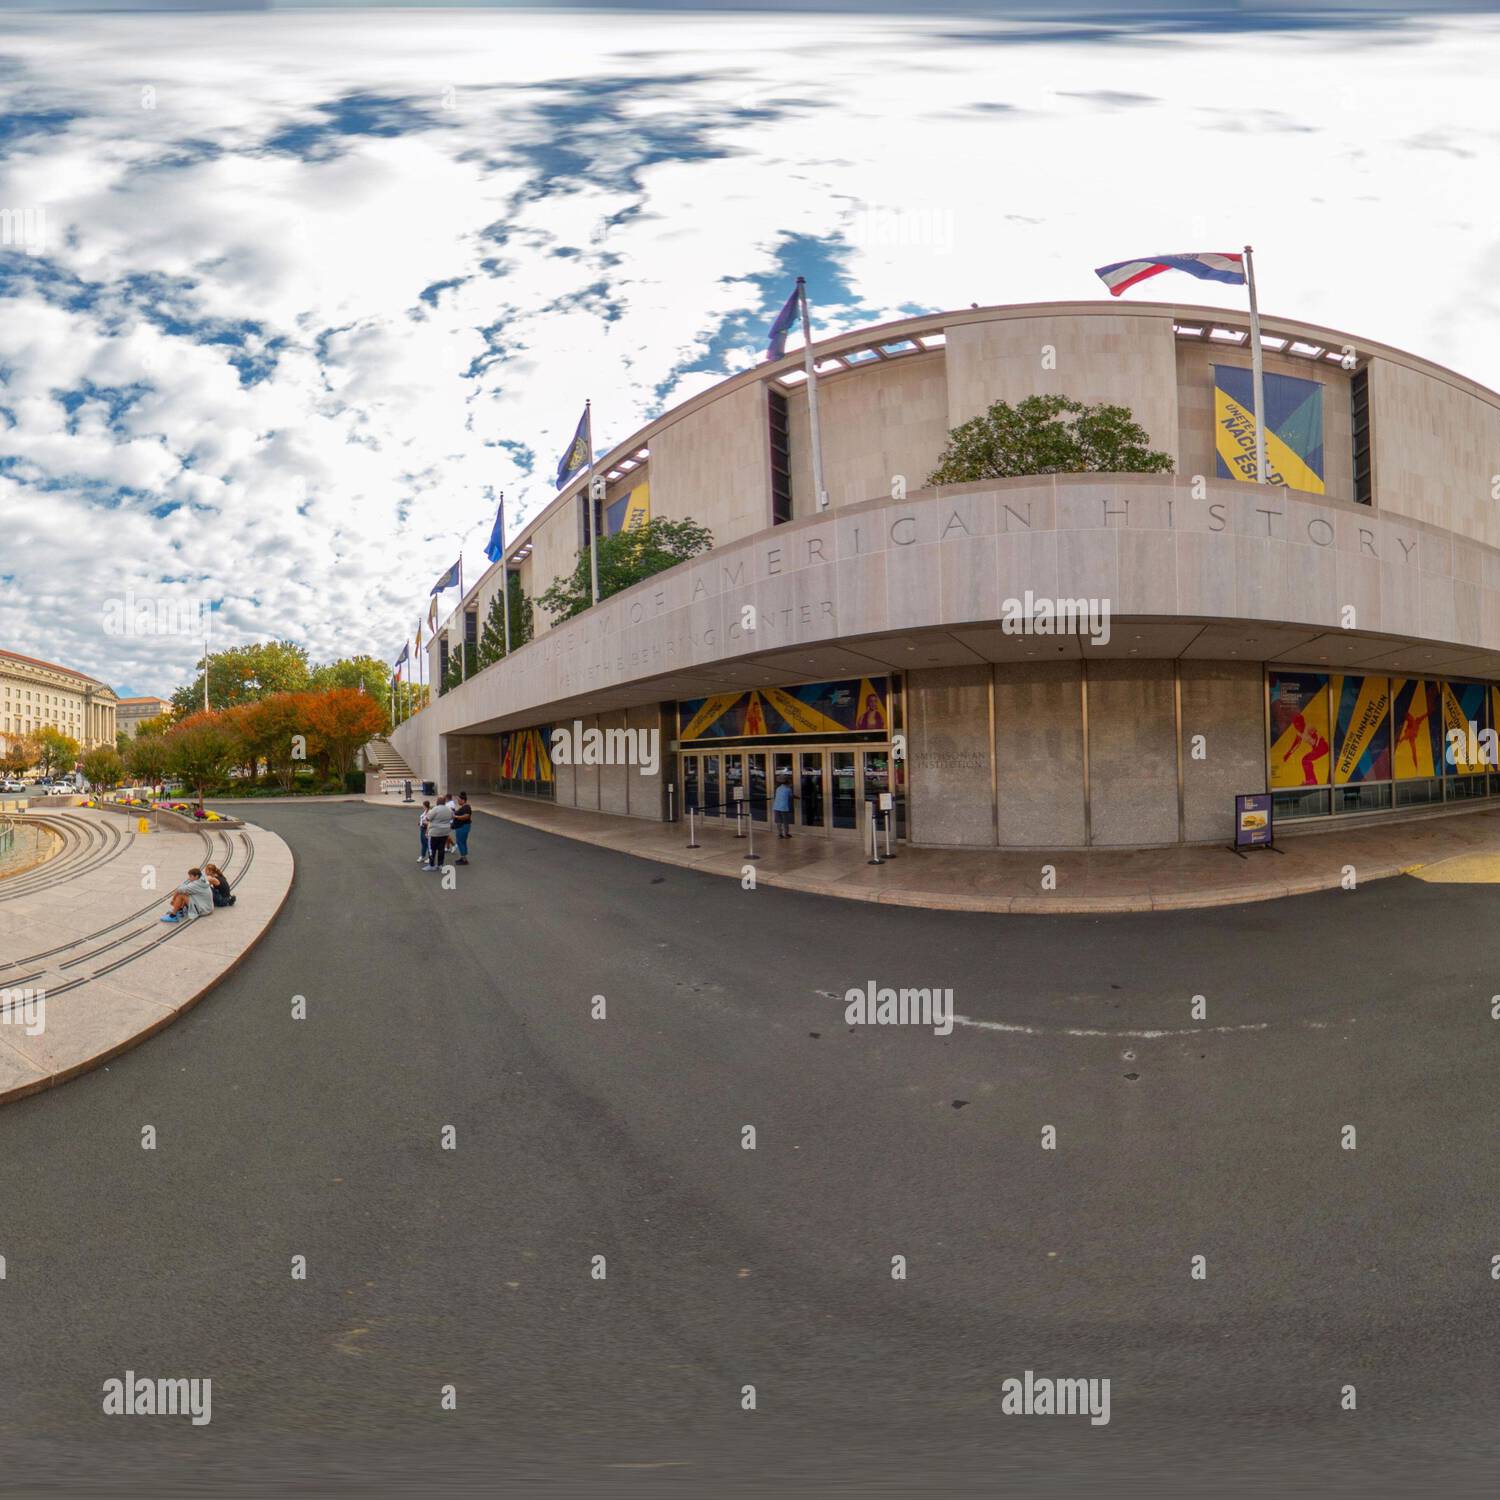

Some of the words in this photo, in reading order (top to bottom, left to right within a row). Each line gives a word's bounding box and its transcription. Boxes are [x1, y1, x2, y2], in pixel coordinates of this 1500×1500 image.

[630, 591, 665, 624] OF
[692, 502, 1033, 601] AMERICAN
[1101, 499, 1417, 563] HISTORY
[728, 601, 838, 640] CNTER
[1341, 701, 1375, 774] ENTERTAINMENT
[1369, 694, 1389, 728] NATION
